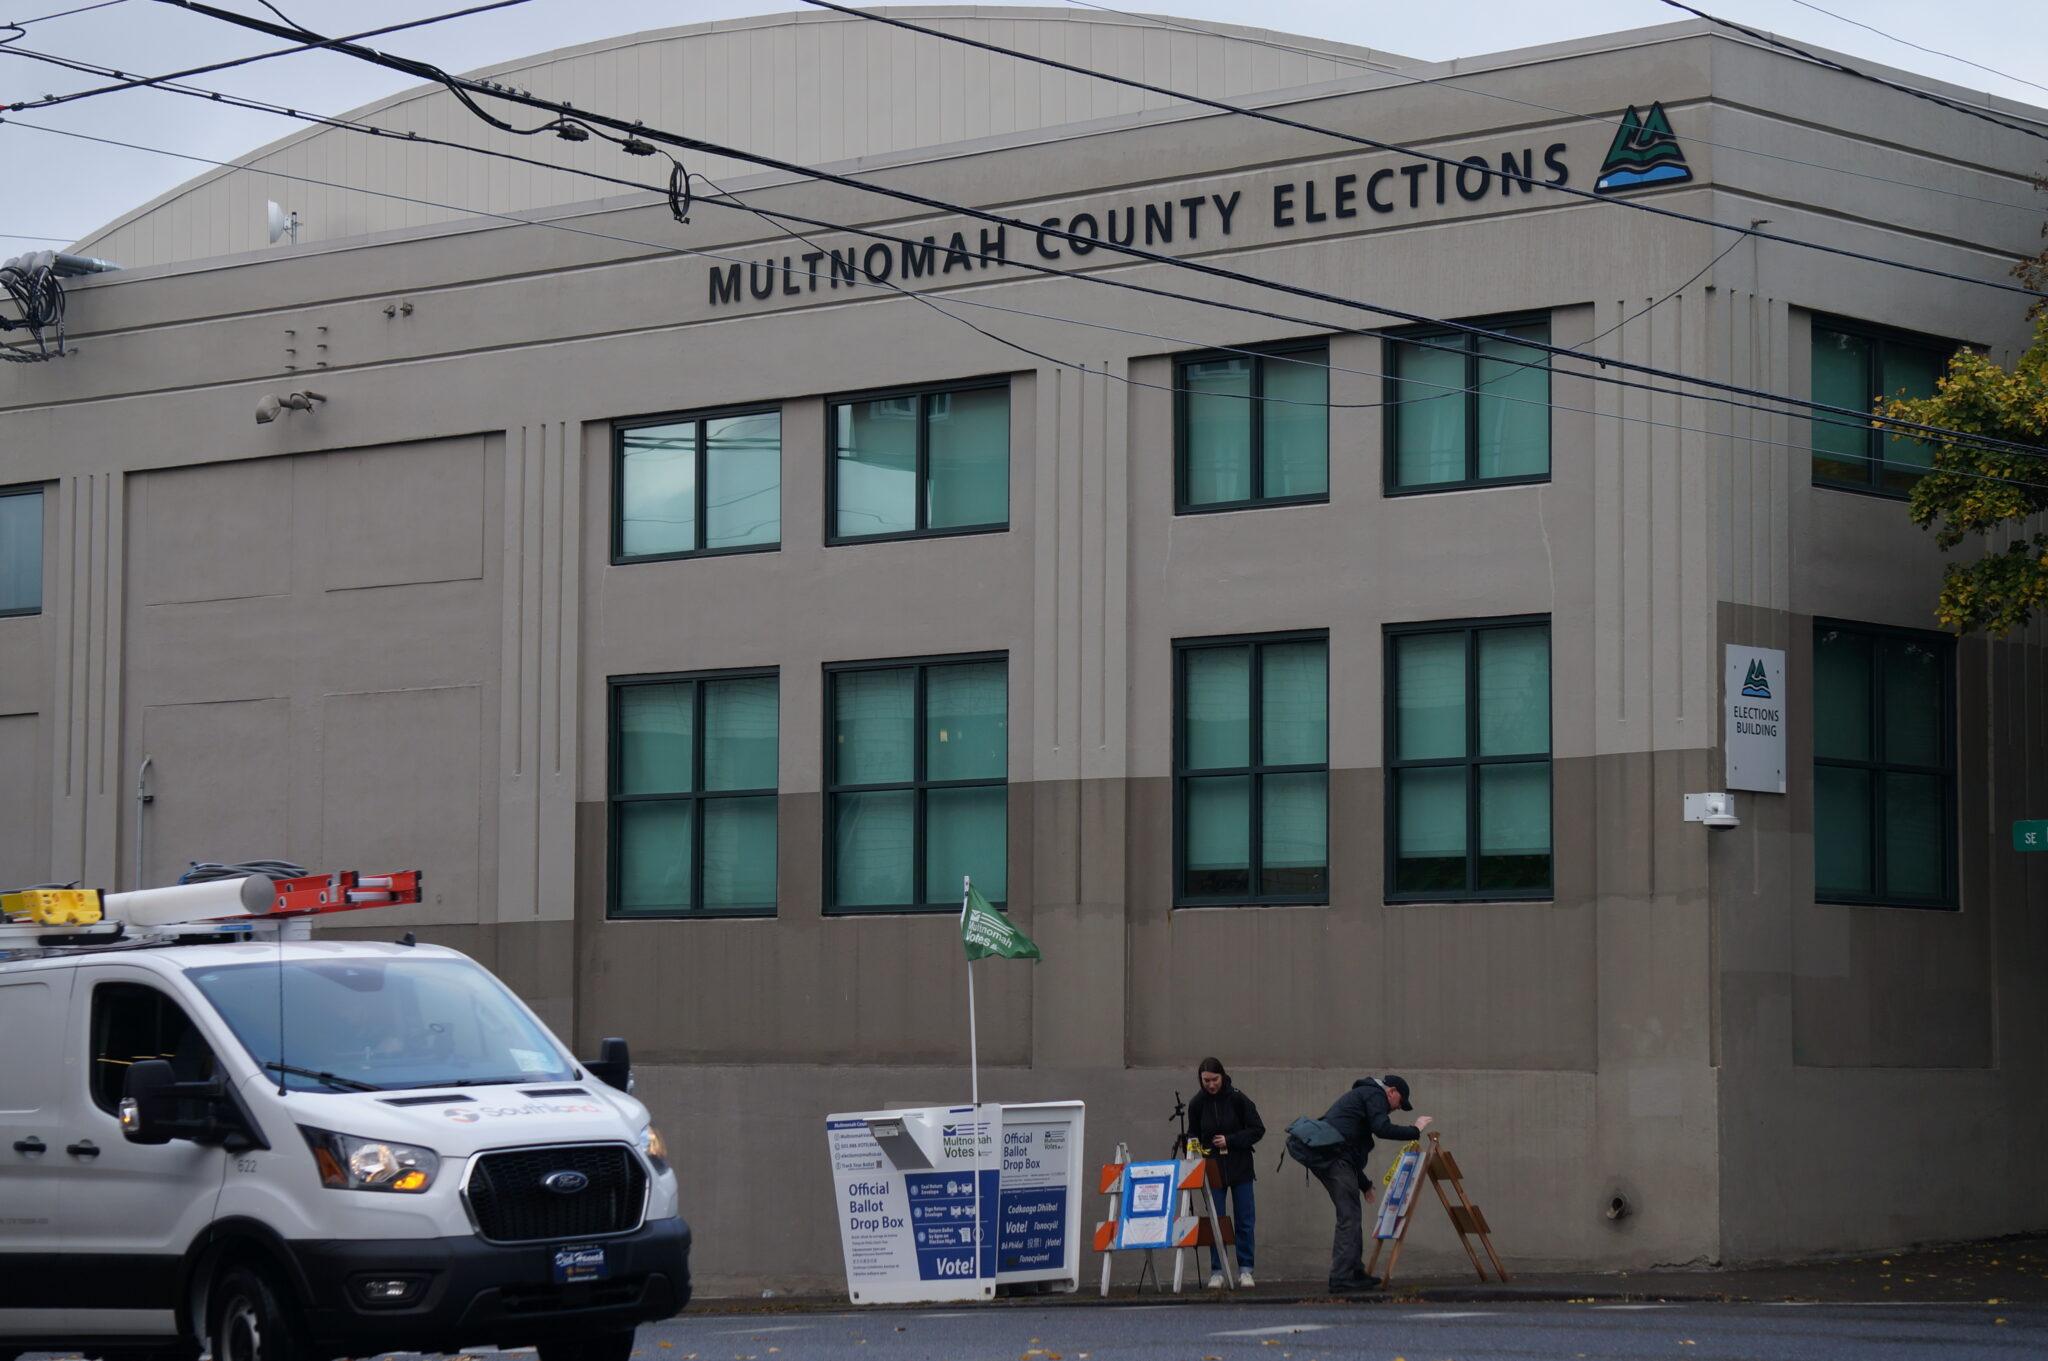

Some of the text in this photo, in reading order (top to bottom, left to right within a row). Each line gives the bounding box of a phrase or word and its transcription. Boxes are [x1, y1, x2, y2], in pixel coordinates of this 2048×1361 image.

[709, 142, 1569, 305] MULTNOMAH COUNTY ELECTIONS
[1734, 706, 1779, 722] ELECTIONS
[1737, 722, 1777, 737] BUILDING
[2025, 832, 2037, 844] SE
[966, 931, 991, 947] Votes
[968, 921, 1012, 948] Multnomah
[1004, 1132, 1032, 1144] Official
[944, 1147, 974, 1158] Votes
[1004, 1146, 1027, 1157] Ballot
[1004, 1158, 1040, 1172] Drop Box
[849, 1181, 889, 1196] Official
[850, 1200, 883, 1213] Ballot
[851, 1216, 904, 1232] Drop Box
[1006, 1221, 1028, 1234] Vote!
[936, 1256, 974, 1275] Vote!
